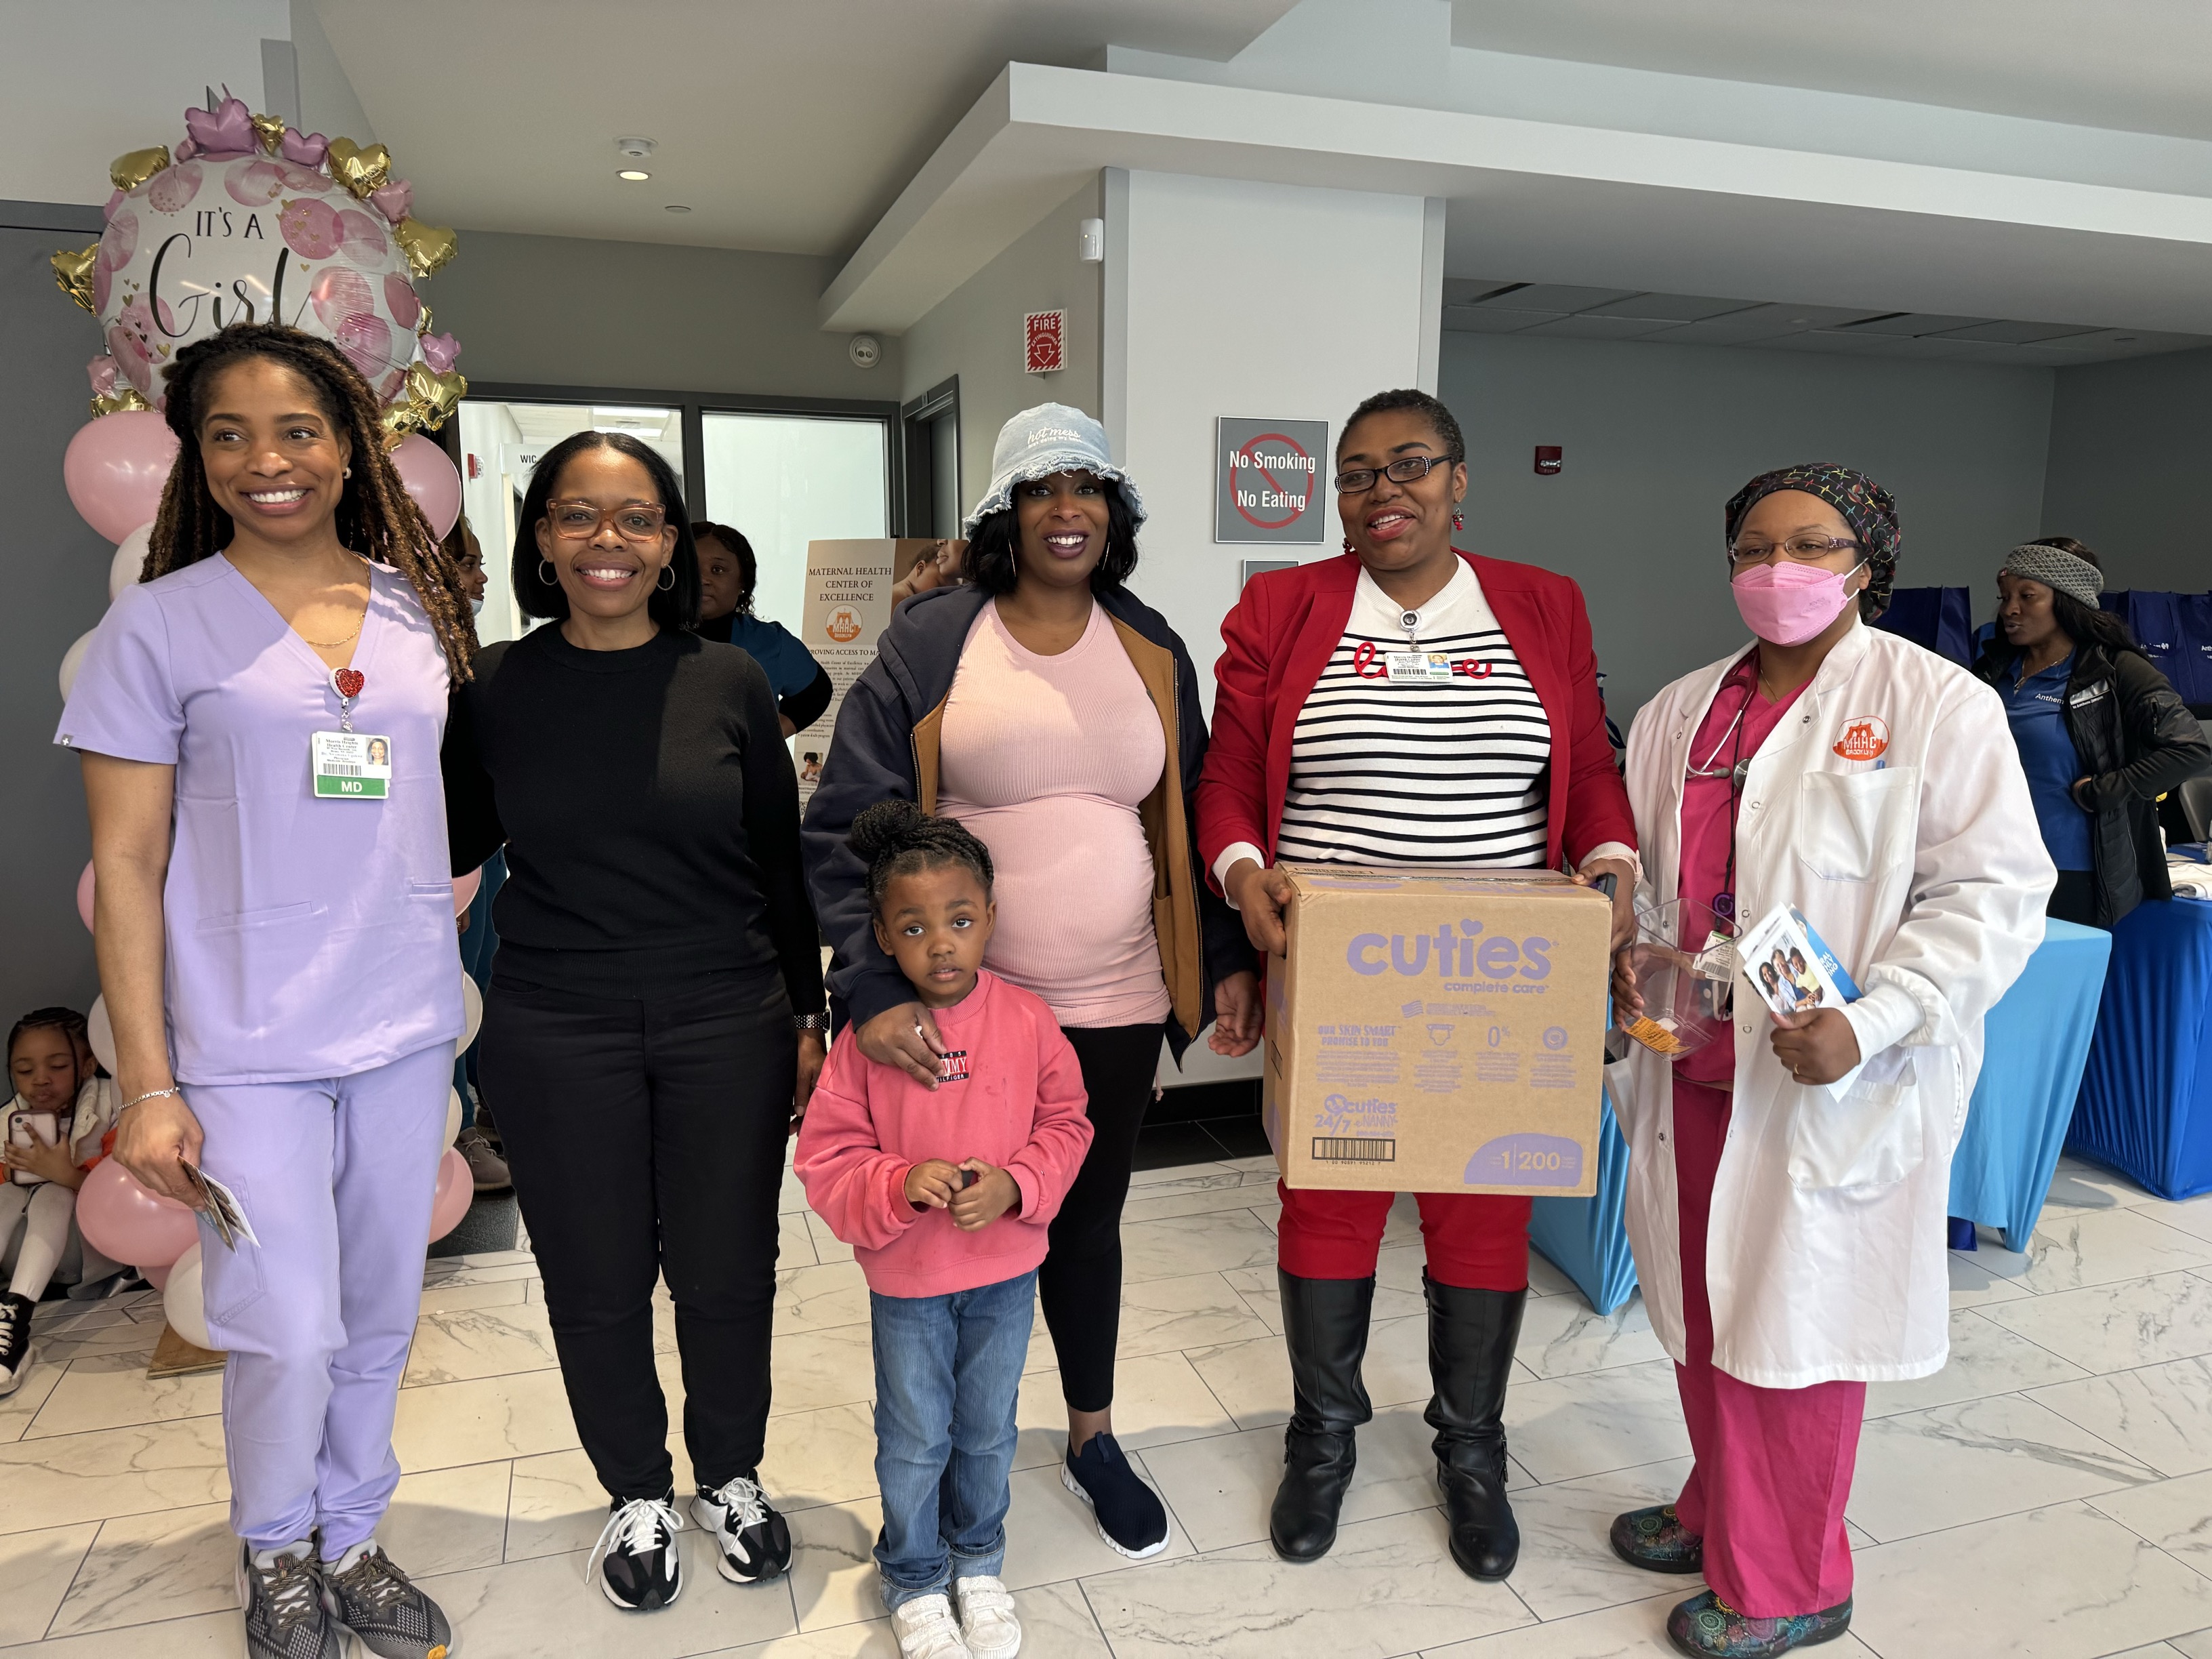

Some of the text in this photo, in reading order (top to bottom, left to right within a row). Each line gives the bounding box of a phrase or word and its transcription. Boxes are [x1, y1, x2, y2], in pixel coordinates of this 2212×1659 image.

[196, 207, 264, 240] IT'S A
[149, 233, 312, 337] Girl
[1033, 318, 1056, 331] FIRE
[1031, 332, 1058, 347] EXTINGUISHER
[1027, 426, 1081, 445] hot mess
[520, 454, 537, 464] WIC
[1229, 451, 1316, 474] No Smoking
[1237, 490, 1306, 512] No Eating
[808, 567, 892, 576] MATERNAL HEALTH
[825, 580, 873, 588] CENTER OF
[819, 593, 874, 601] EXCELLENCE
[1843, 736, 1877, 750] MHHC
[341, 781, 363, 793] MD
[1347, 918, 1552, 981] cuties
[1443, 982, 1546, 994] complete care
[1318, 1025, 1395, 1037] OUR SKIN SMART
[1488, 1025, 1511, 1047] 0%
[1322, 1036, 1388, 1047] PROMISE TO YOU
[1346, 1098, 1396, 1114] cuties
[1315, 1114, 1351, 1136] 24/7
[1501, 1151, 1510, 1170] 1
[1518, 1151, 1561, 1171] 200
